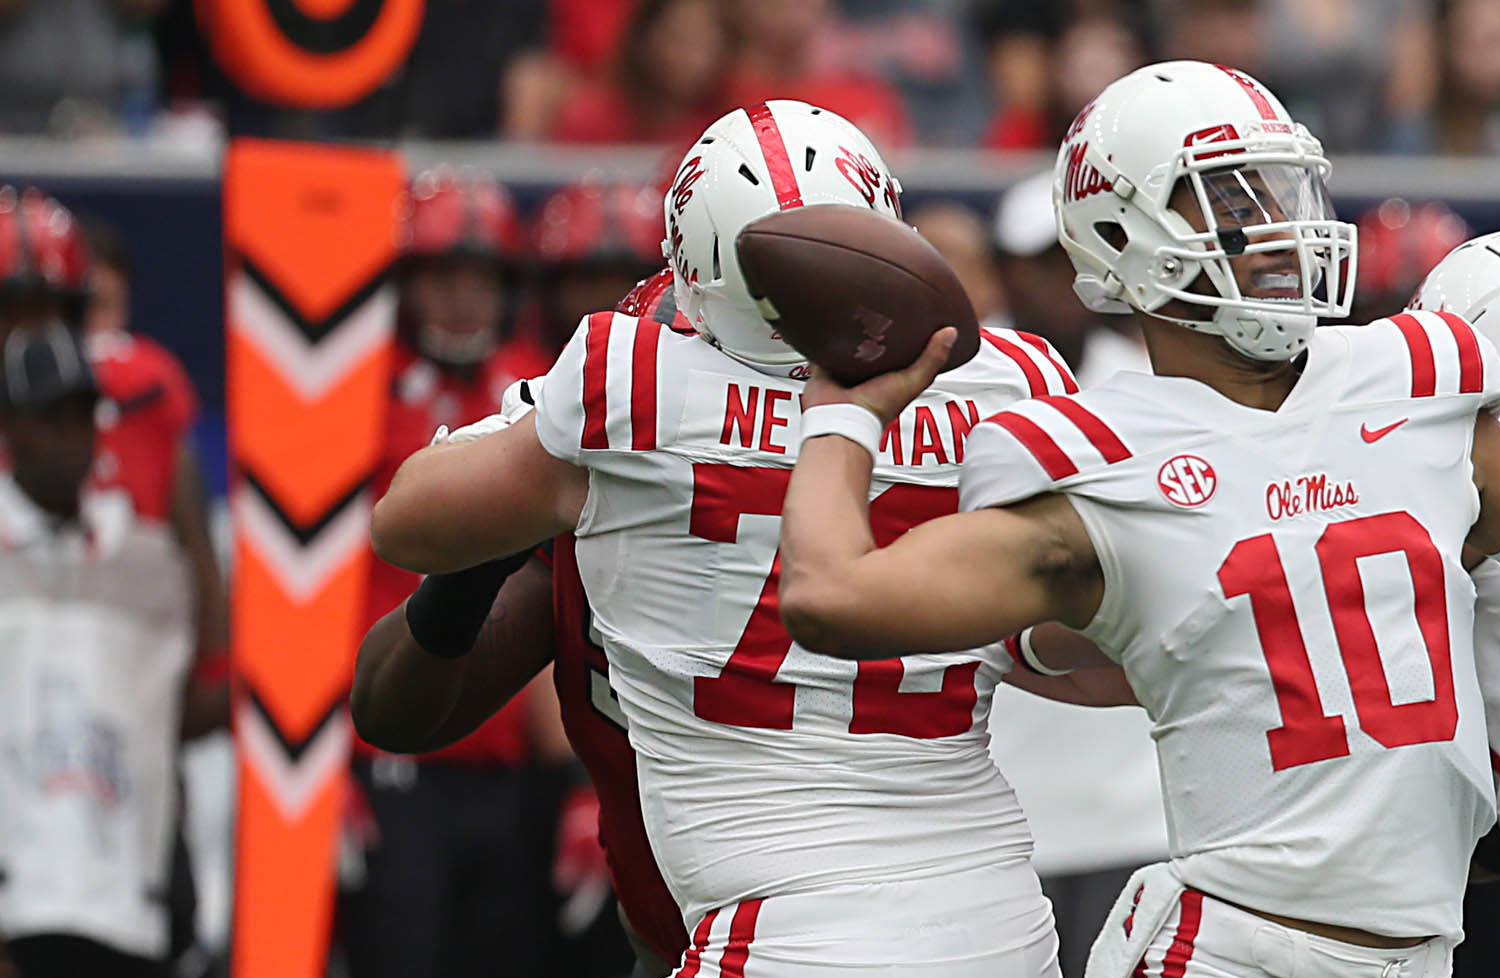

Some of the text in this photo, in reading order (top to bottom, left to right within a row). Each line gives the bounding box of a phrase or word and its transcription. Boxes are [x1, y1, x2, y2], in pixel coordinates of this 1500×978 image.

[672, 155, 705, 216] Ole
[835, 145, 882, 206] Ole
[719, 382, 982, 467] NEMAN
[1158, 455, 1217, 506] SEC
[1265, 473, 1360, 521] Ole Miss
[1216, 510, 1459, 773] 10
